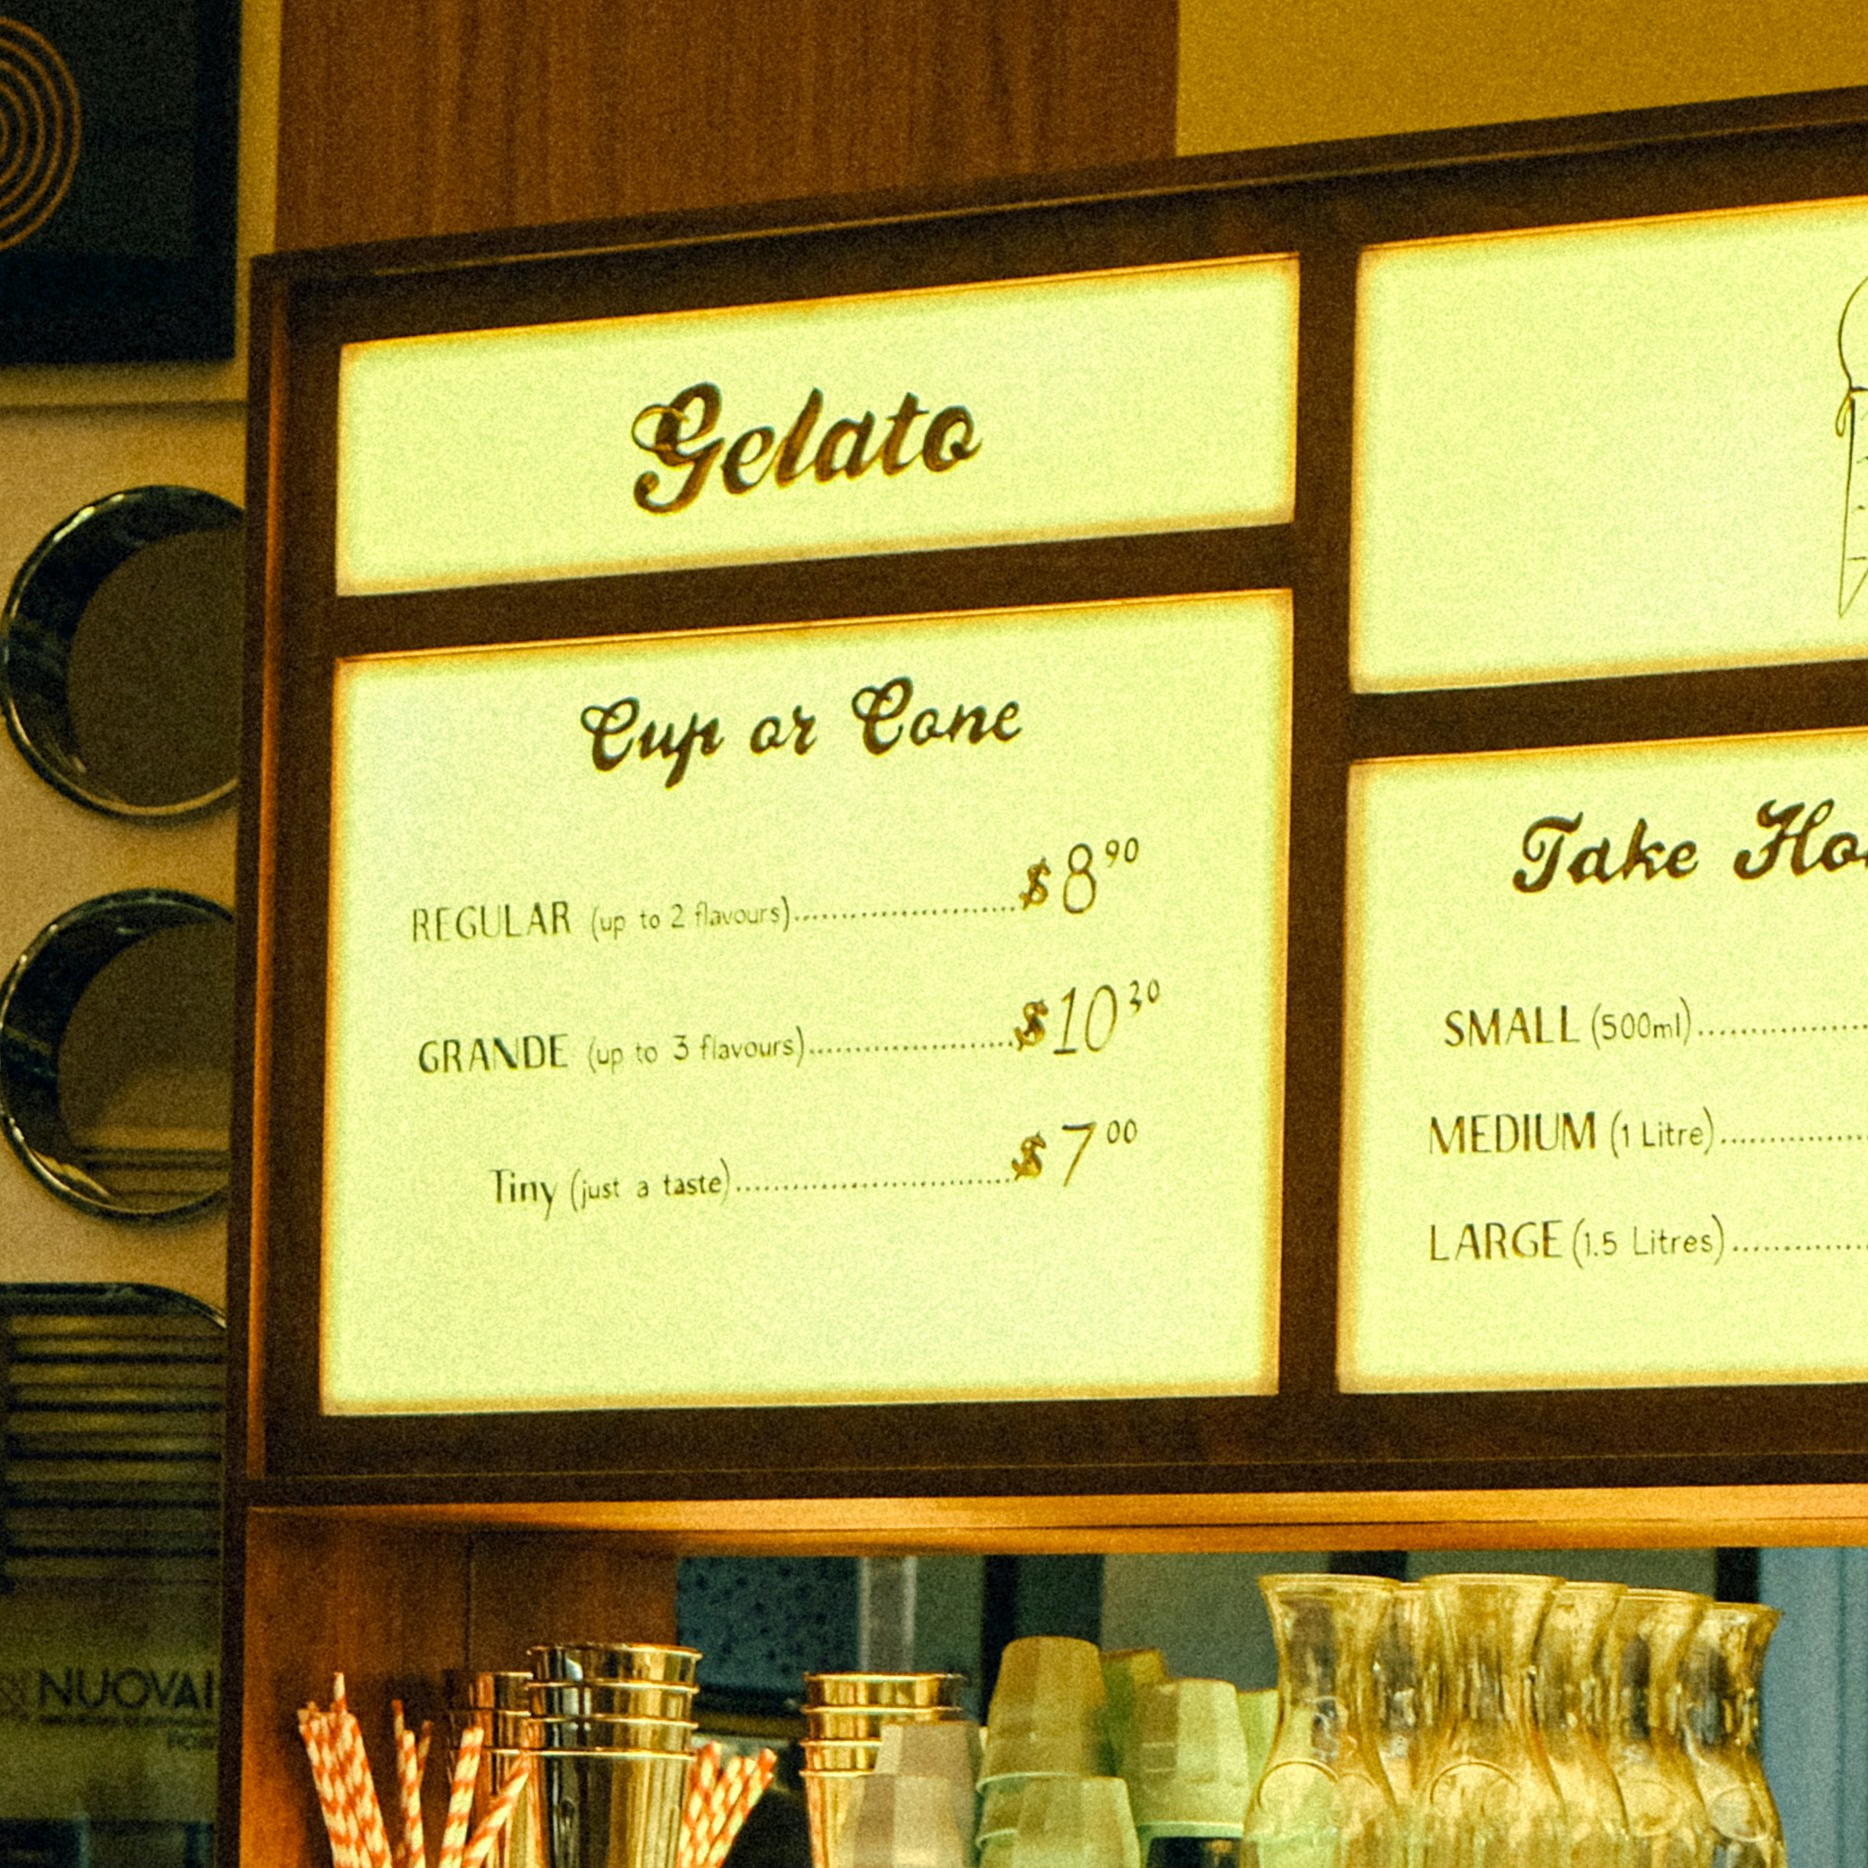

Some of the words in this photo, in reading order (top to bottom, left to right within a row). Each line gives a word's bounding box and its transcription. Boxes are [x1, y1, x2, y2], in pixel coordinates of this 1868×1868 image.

[632, 383, 979, 514] Gelato
[581, 698, 723, 788] Cup
[750, 712, 815, 755] or
[851, 677, 1021, 755] Cone
[1513, 813, 1697, 893] Take
[413, 900, 570, 941] REGULAR
[591, 907, 625, 942] (up
[640, 912, 661, 930] to
[671, 903, 684, 929] 2
[1445, 1005, 1581, 1047] SMALL
[1591, 997, 1691, 1050] (500ml)
[418, 1033, 570, 1074] GRANDE
[587, 1037, 624, 1078] (up
[635, 1044, 658, 1064] to
[674, 1035, 689, 1061] 3
[1431, 1111, 1595, 1153] MEDIUM
[1611, 1111, 1629, 1156] (1
[1642, 1107, 1713, 1154] Litre)
[489, 1167, 555, 1219] Tiny
[570, 1169, 619, 1212] (just
[637, 1181, 649, 1198] a
[663, 1159, 730, 1204] taste)
[1430, 1221, 1563, 1262] LARGE
[1572, 1218, 1617, 1269] (1.5
[1634, 1214, 1724, 1264] Litres)
